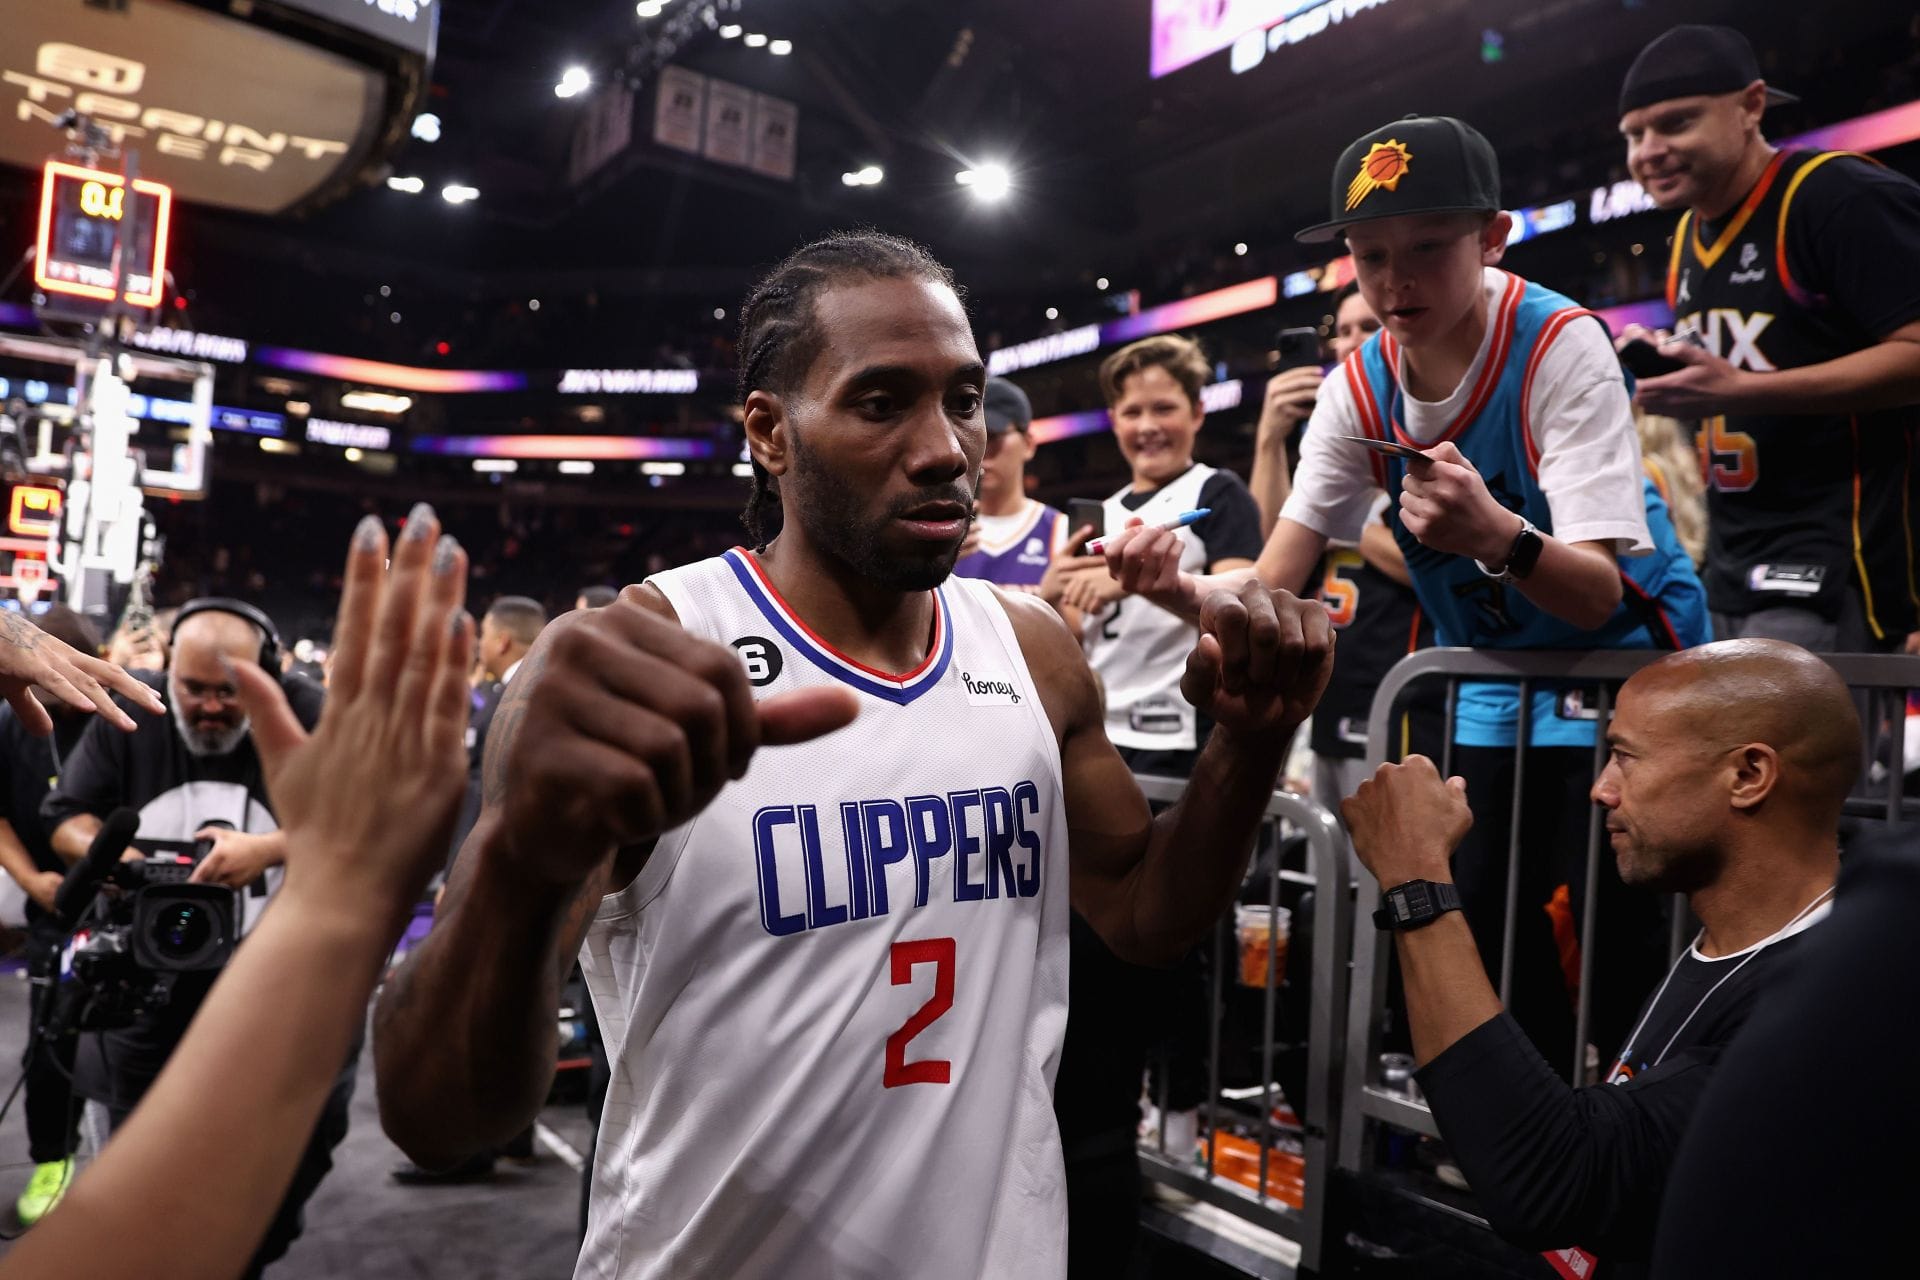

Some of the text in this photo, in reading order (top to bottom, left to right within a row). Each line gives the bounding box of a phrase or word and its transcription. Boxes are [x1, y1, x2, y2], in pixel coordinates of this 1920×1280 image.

[1675, 308, 1778, 371] HX
[737, 643, 770, 680] 6
[960, 671, 1021, 704] honey
[752, 780, 1042, 937] CLIPPERS
[883, 937, 957, 1089] 2
